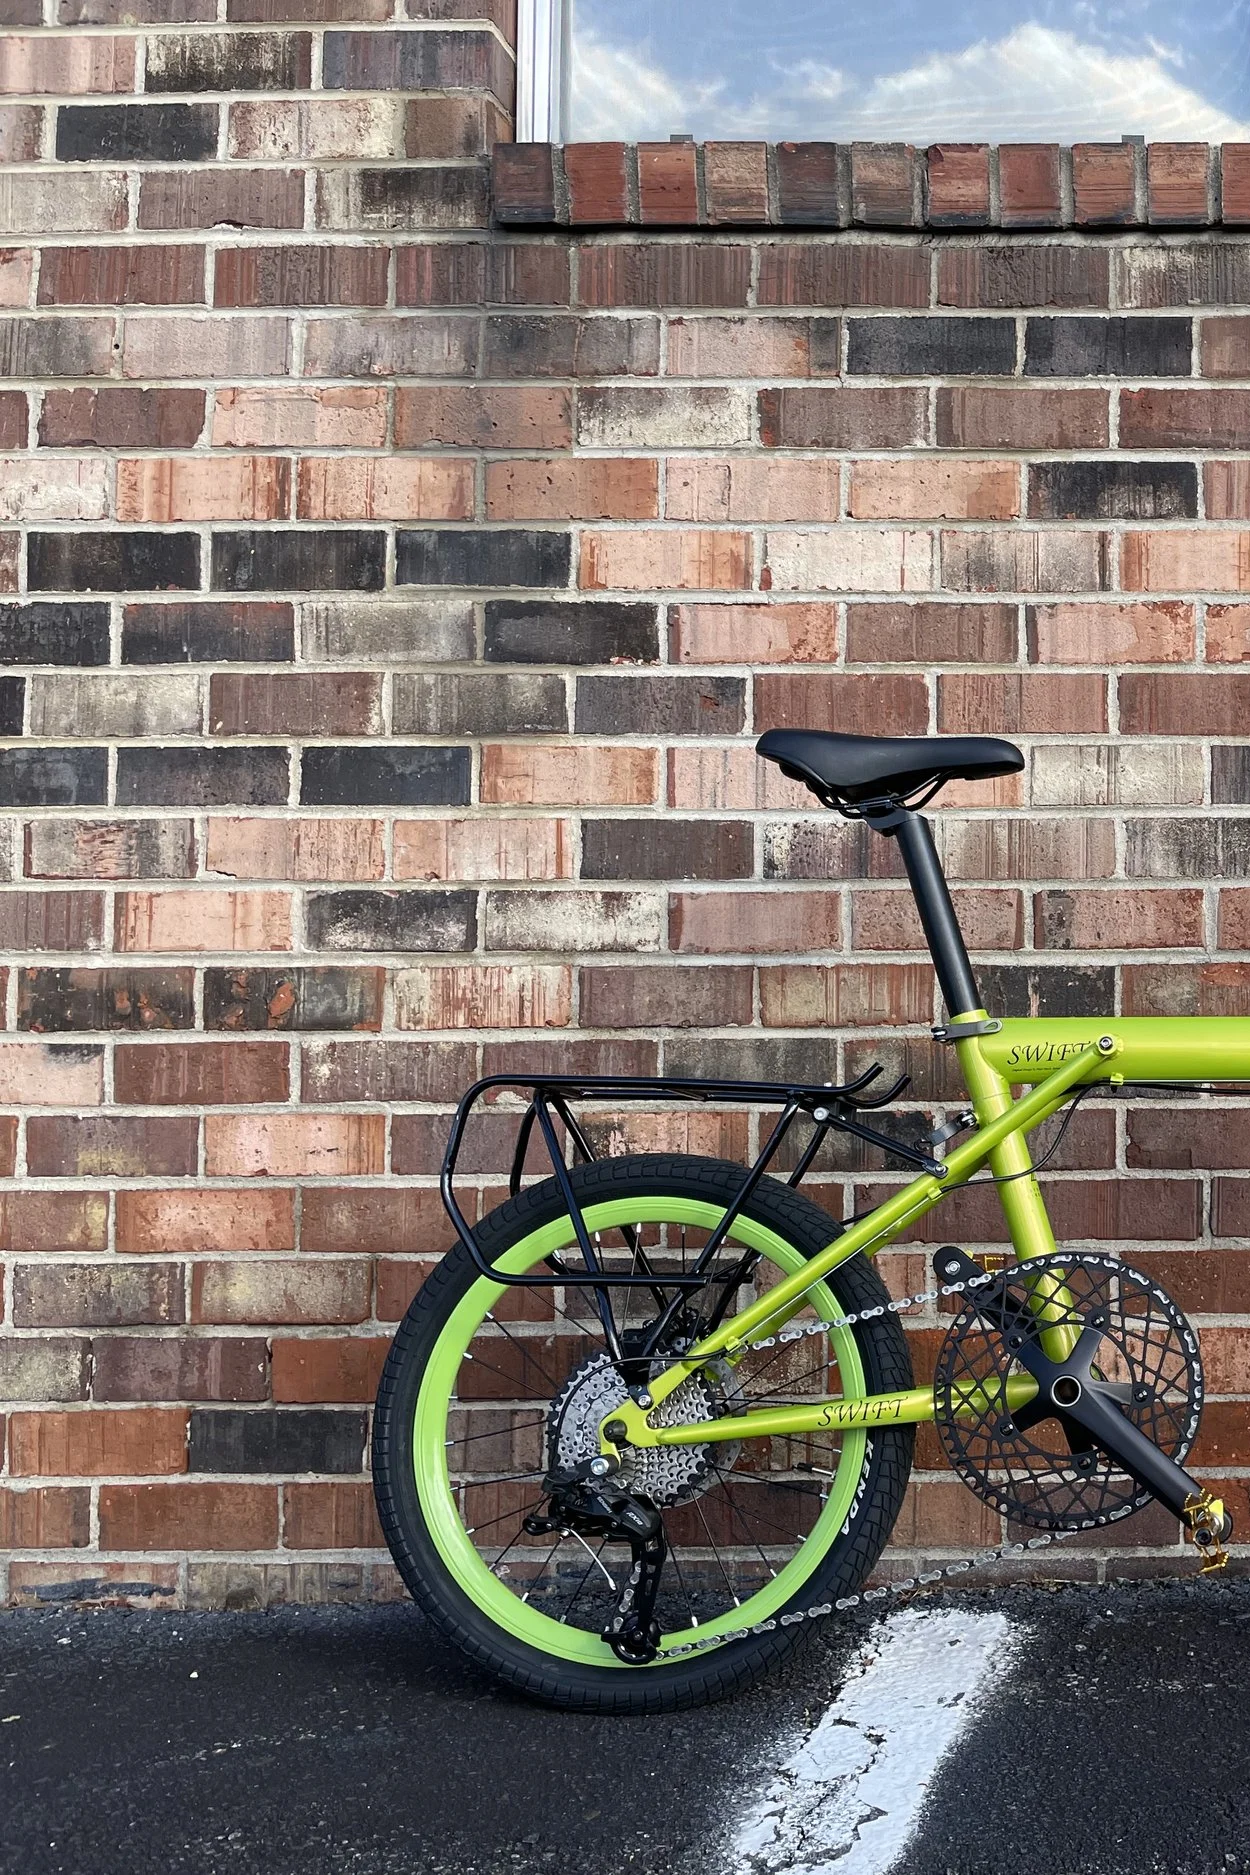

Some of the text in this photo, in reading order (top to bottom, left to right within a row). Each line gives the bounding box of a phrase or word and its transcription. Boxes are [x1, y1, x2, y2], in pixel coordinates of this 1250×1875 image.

[1007, 1041, 1091, 1065] SWIFT
[817, 1396, 909, 1427] SWIFT
[841, 1438, 874, 1535] KENDA
